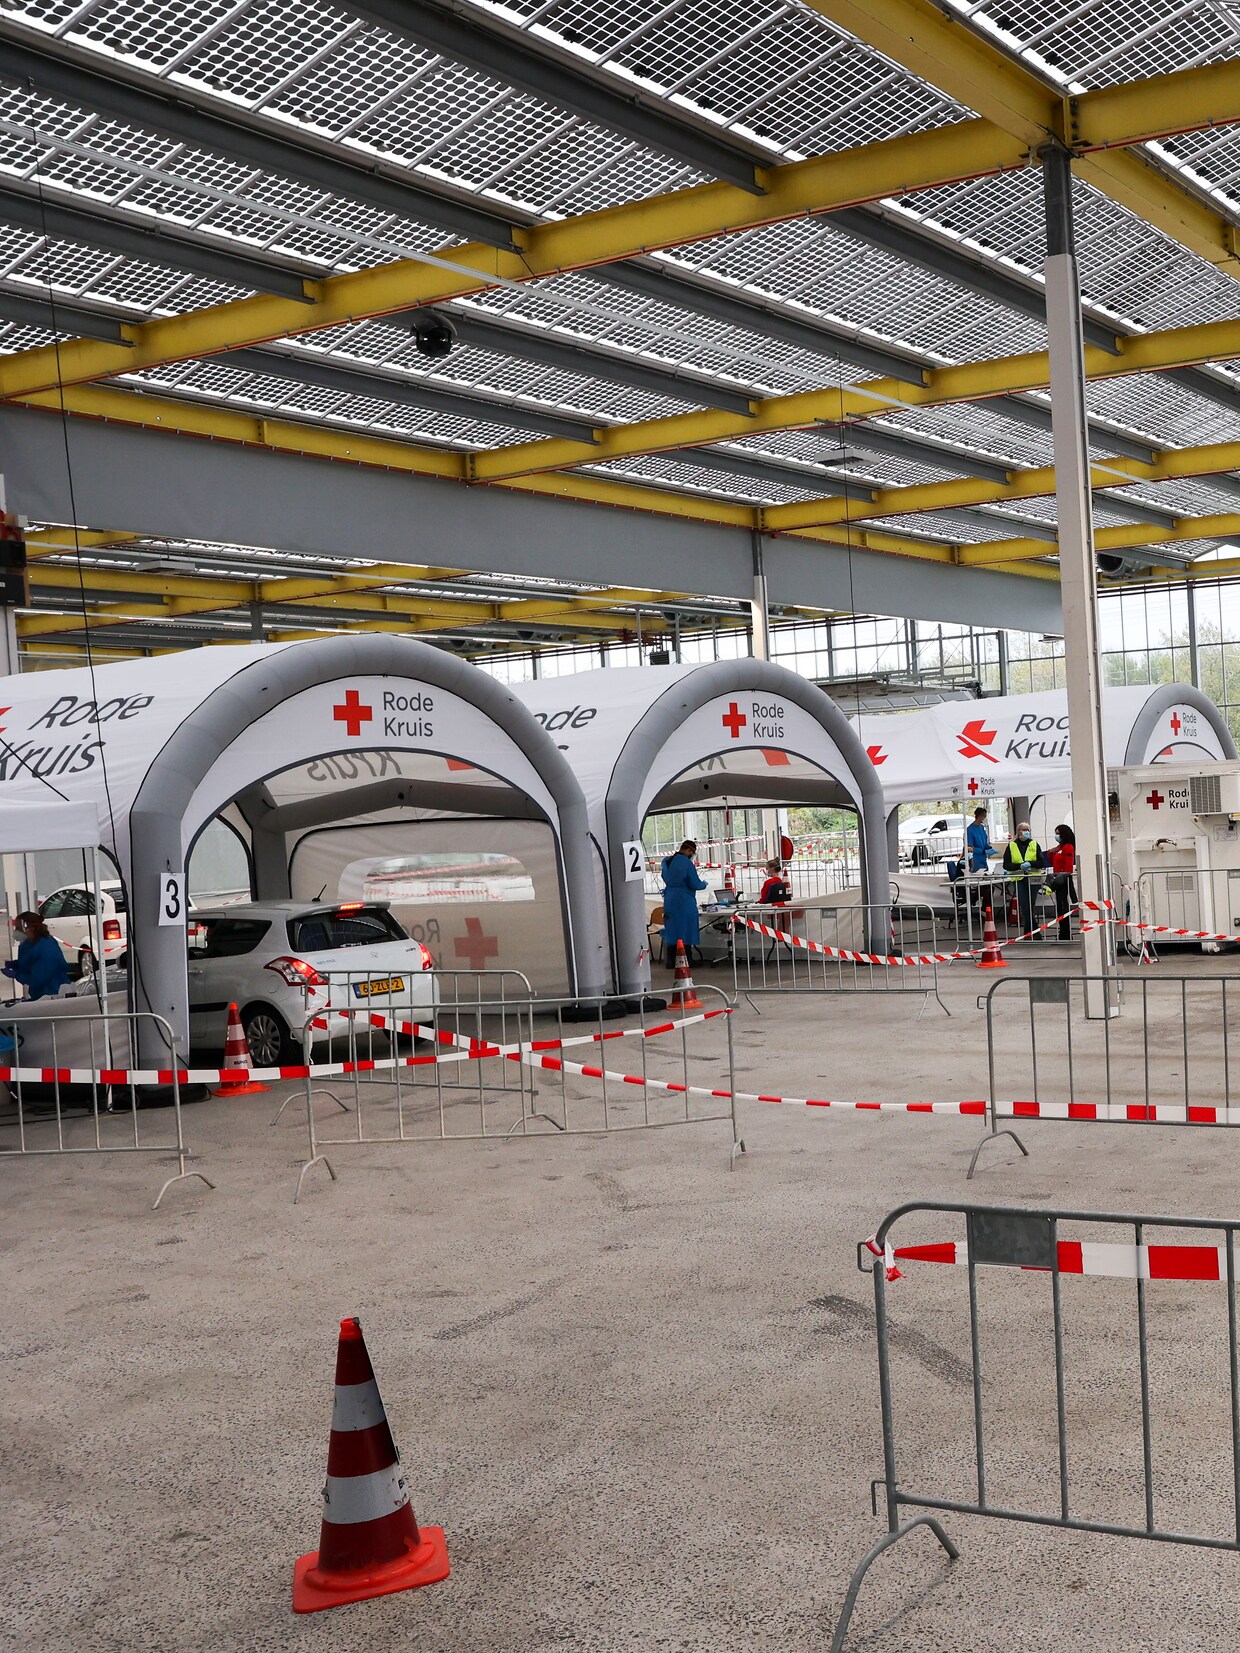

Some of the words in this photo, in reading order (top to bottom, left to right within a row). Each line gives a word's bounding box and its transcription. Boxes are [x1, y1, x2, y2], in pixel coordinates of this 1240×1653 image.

[383, 691, 434, 712] Rode
[27, 693, 155, 731] Rode
[752, 703, 785, 719] Rode
[1182, 712, 1197, 724] Rode
[384, 717, 434, 737] Kruis
[753, 722, 785, 738] Kruis
[1015, 714, 1070, 733] Ro
[1183, 725, 1198, 737] Kruis
[1004, 735, 1071, 759] Krui
[0, 733, 107, 781] Kruis
[980, 776, 995, 786] Rode
[980, 787, 995, 796] Kruis
[1168, 788, 1190, 798] Rod
[1169, 799, 1189, 809] Krui
[629, 846, 641, 873] 2
[166, 879, 180, 919] 3
